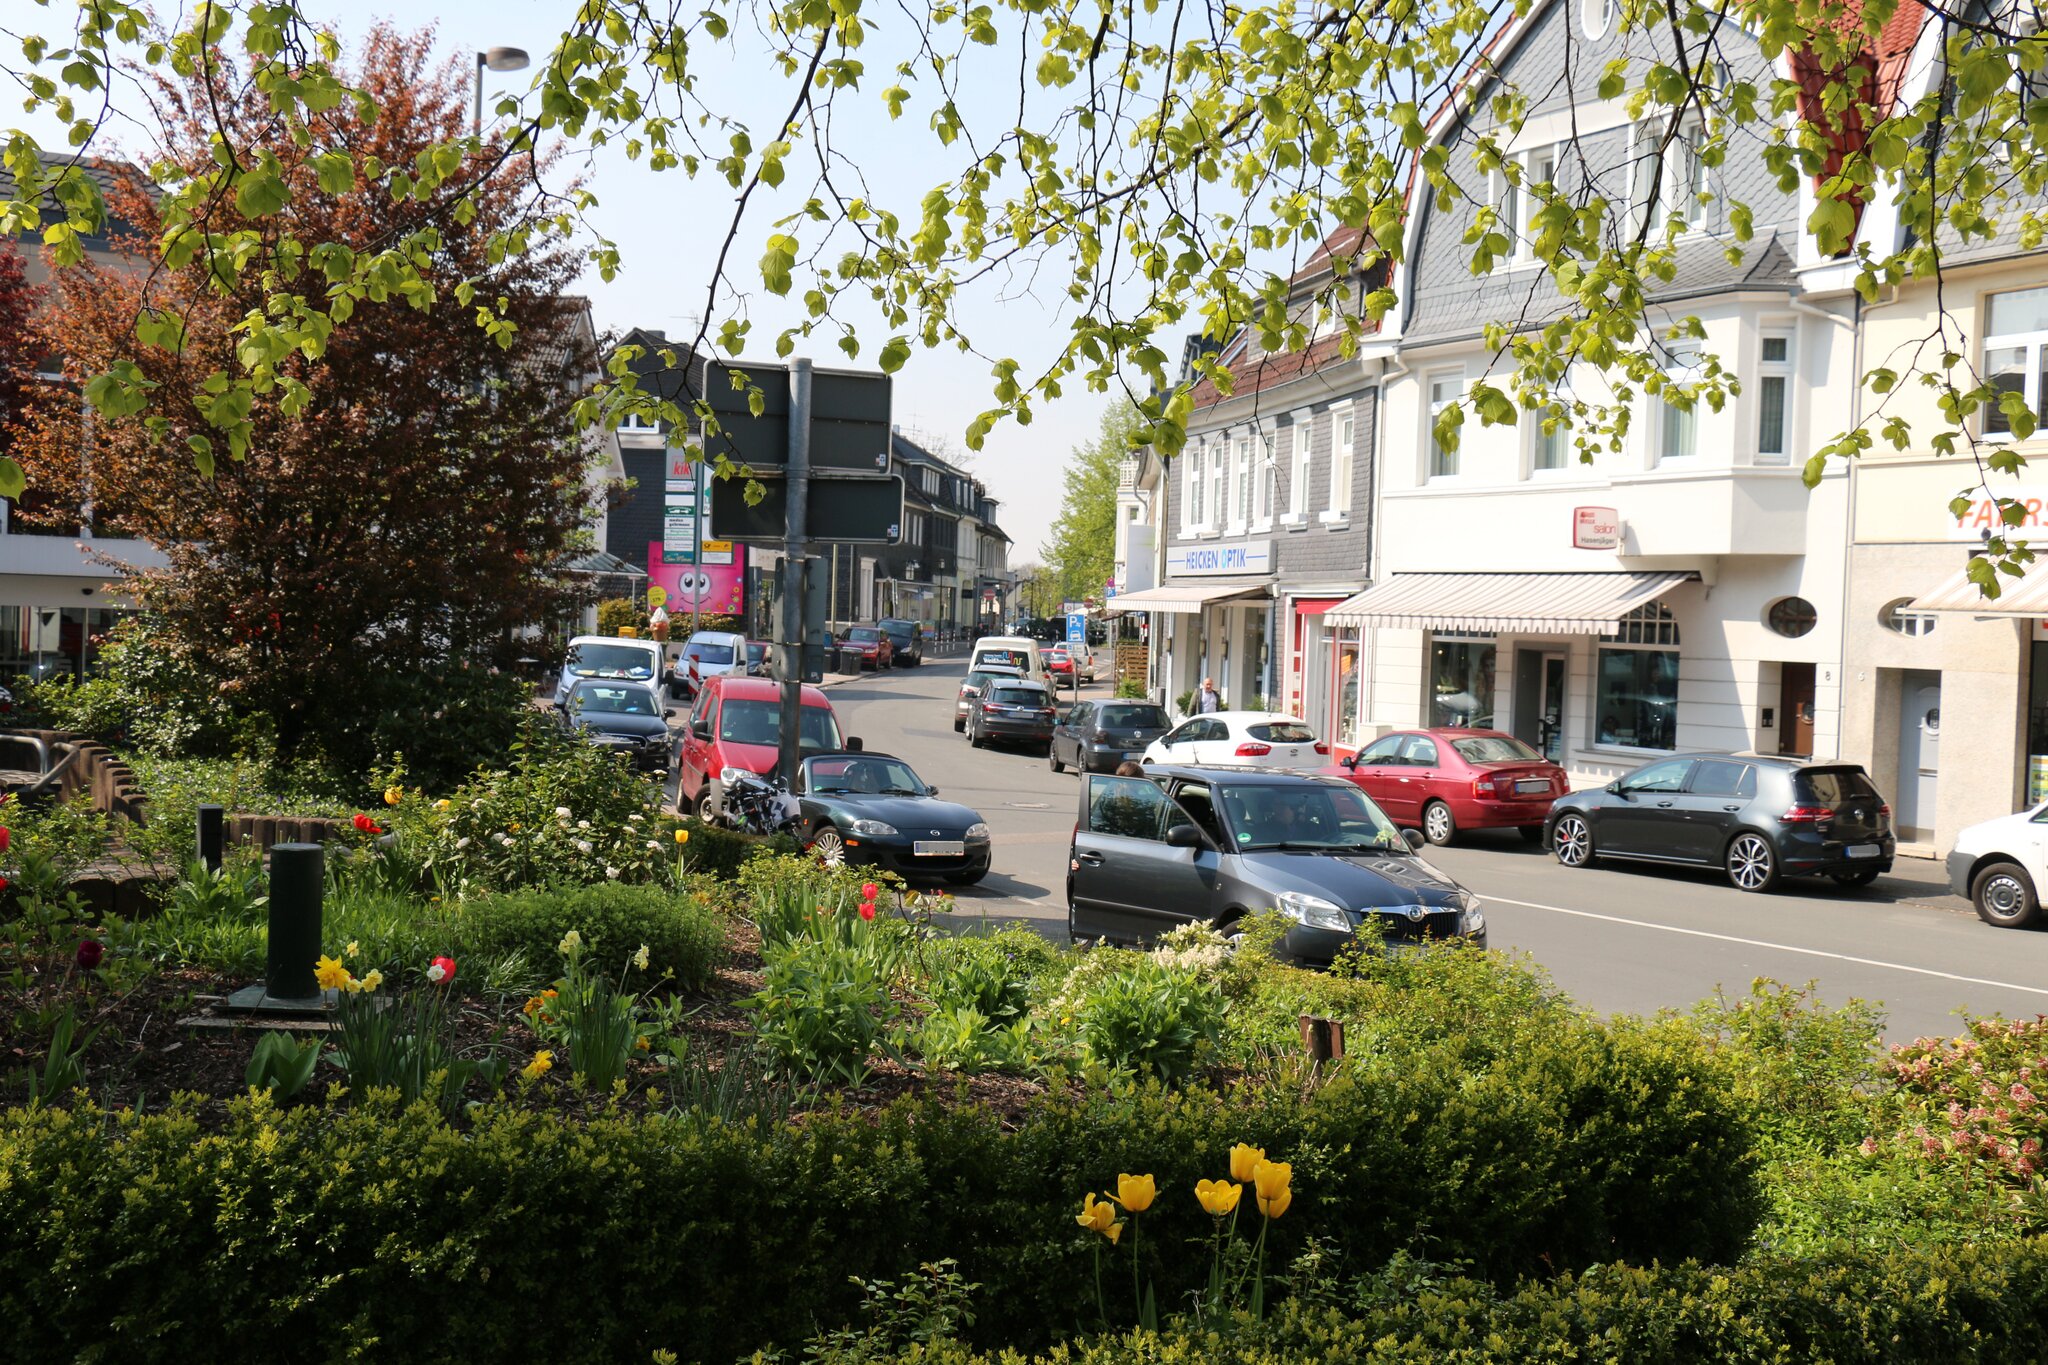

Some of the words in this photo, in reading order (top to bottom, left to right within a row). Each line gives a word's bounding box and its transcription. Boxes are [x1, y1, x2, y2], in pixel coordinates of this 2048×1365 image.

[1186, 550, 1219, 570] HEICKEN
[1221, 548, 1247, 569] OPTIK
[1825, 671, 1831, 681] 8
[1858, 671, 1865, 682] 6
